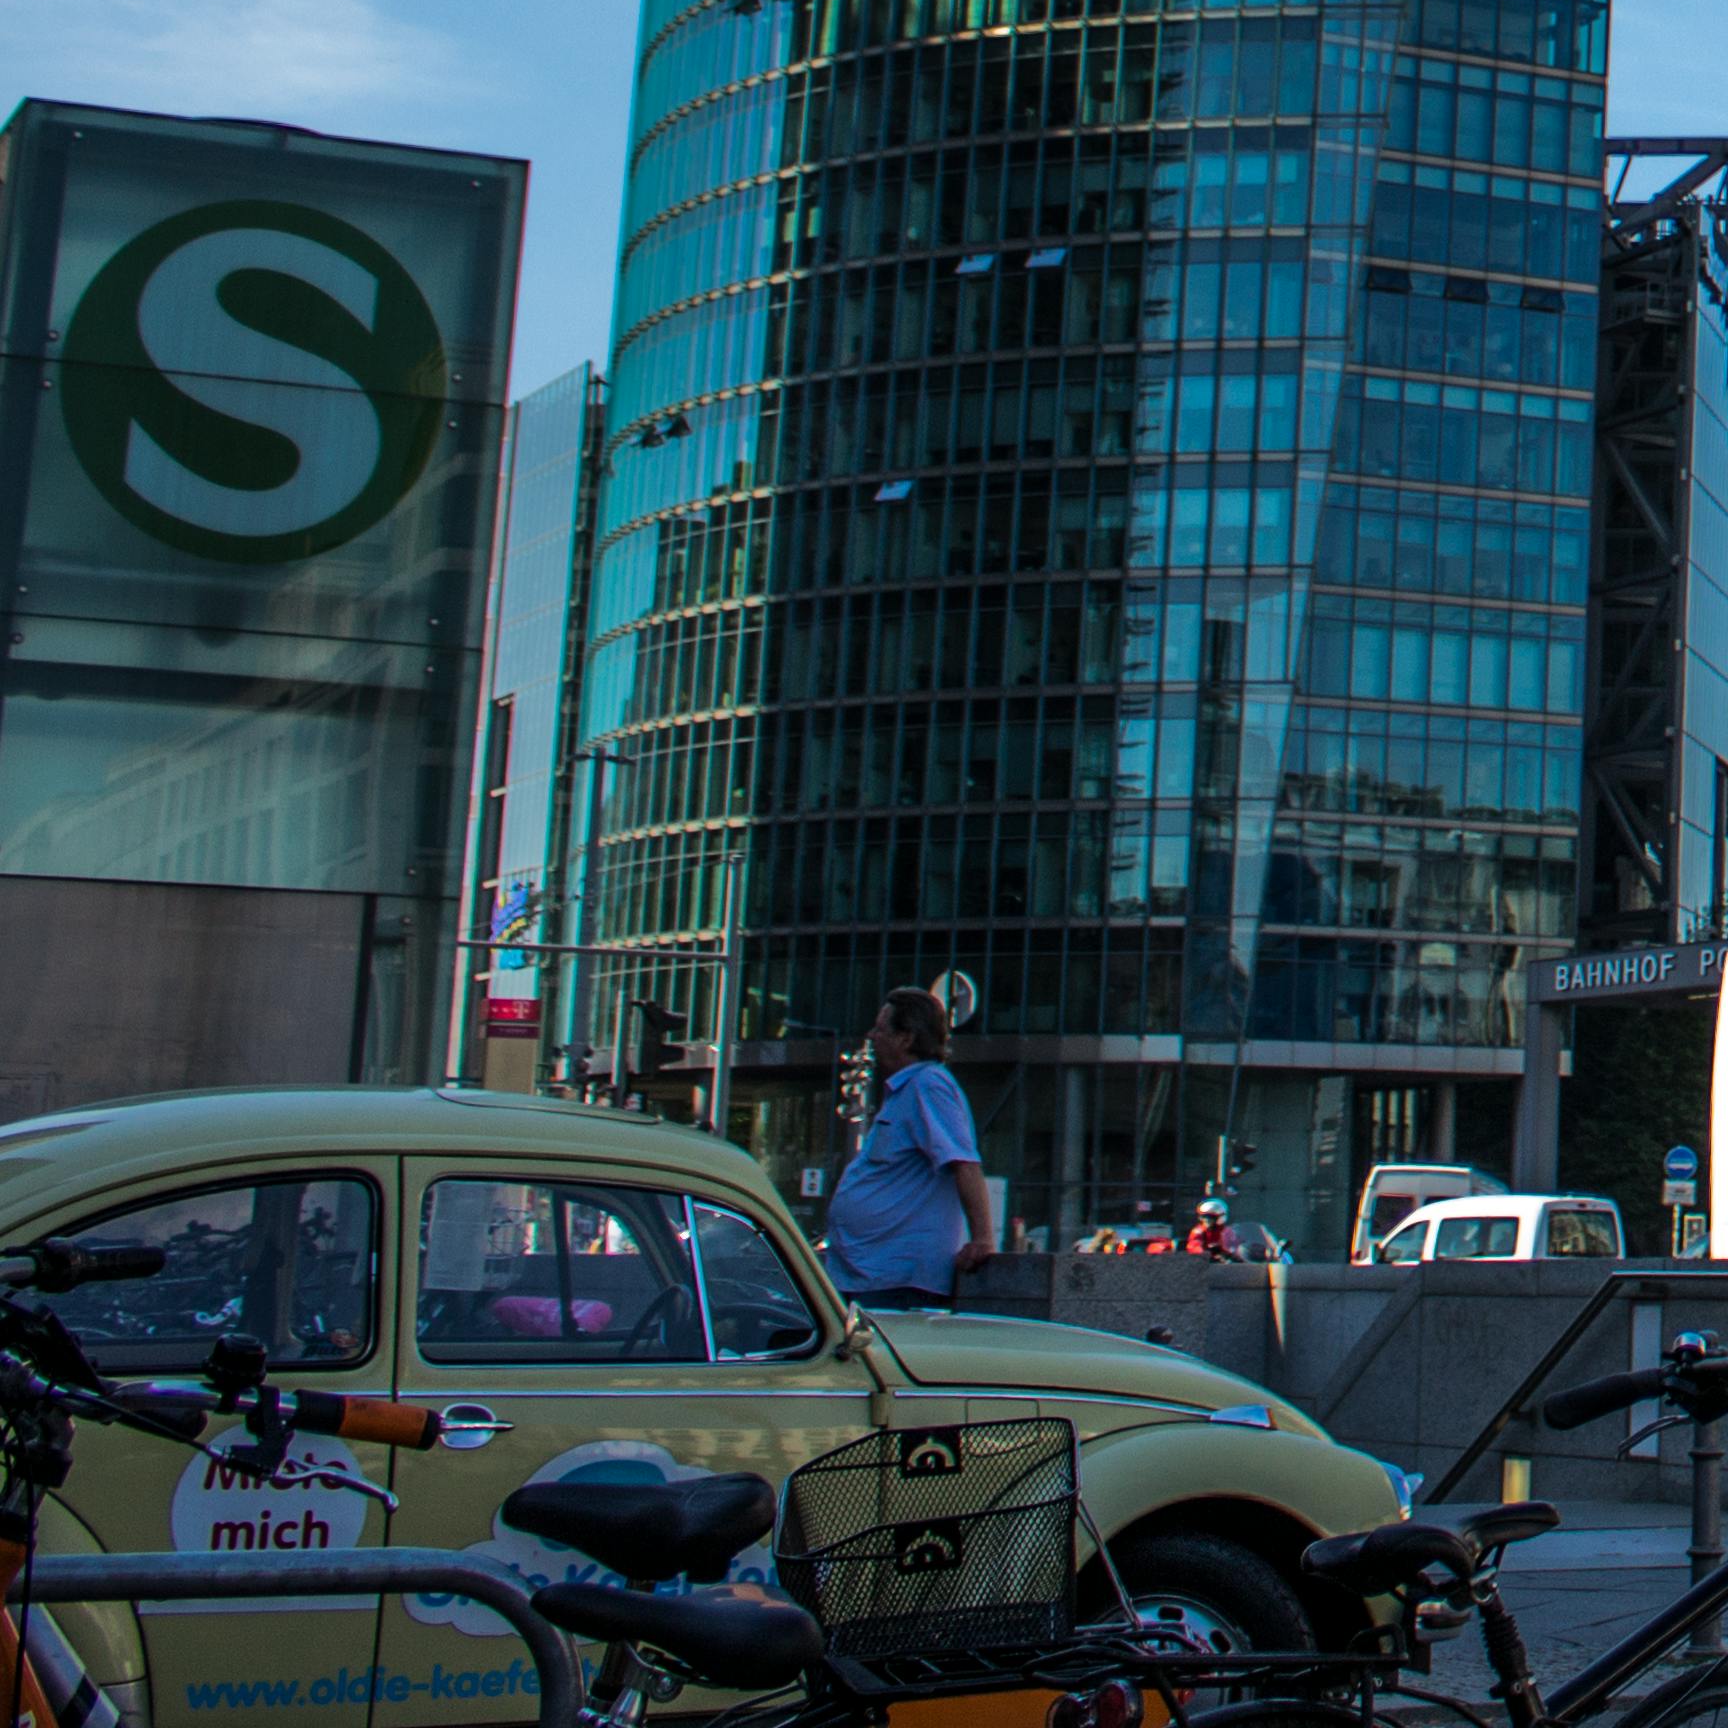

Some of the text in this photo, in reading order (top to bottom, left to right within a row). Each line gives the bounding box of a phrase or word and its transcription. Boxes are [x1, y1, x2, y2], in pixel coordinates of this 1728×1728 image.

[123, 226, 382, 538] S
[1554, 951, 1677, 992] BAHNHOF
[210, 1508, 330, 1550] mich
